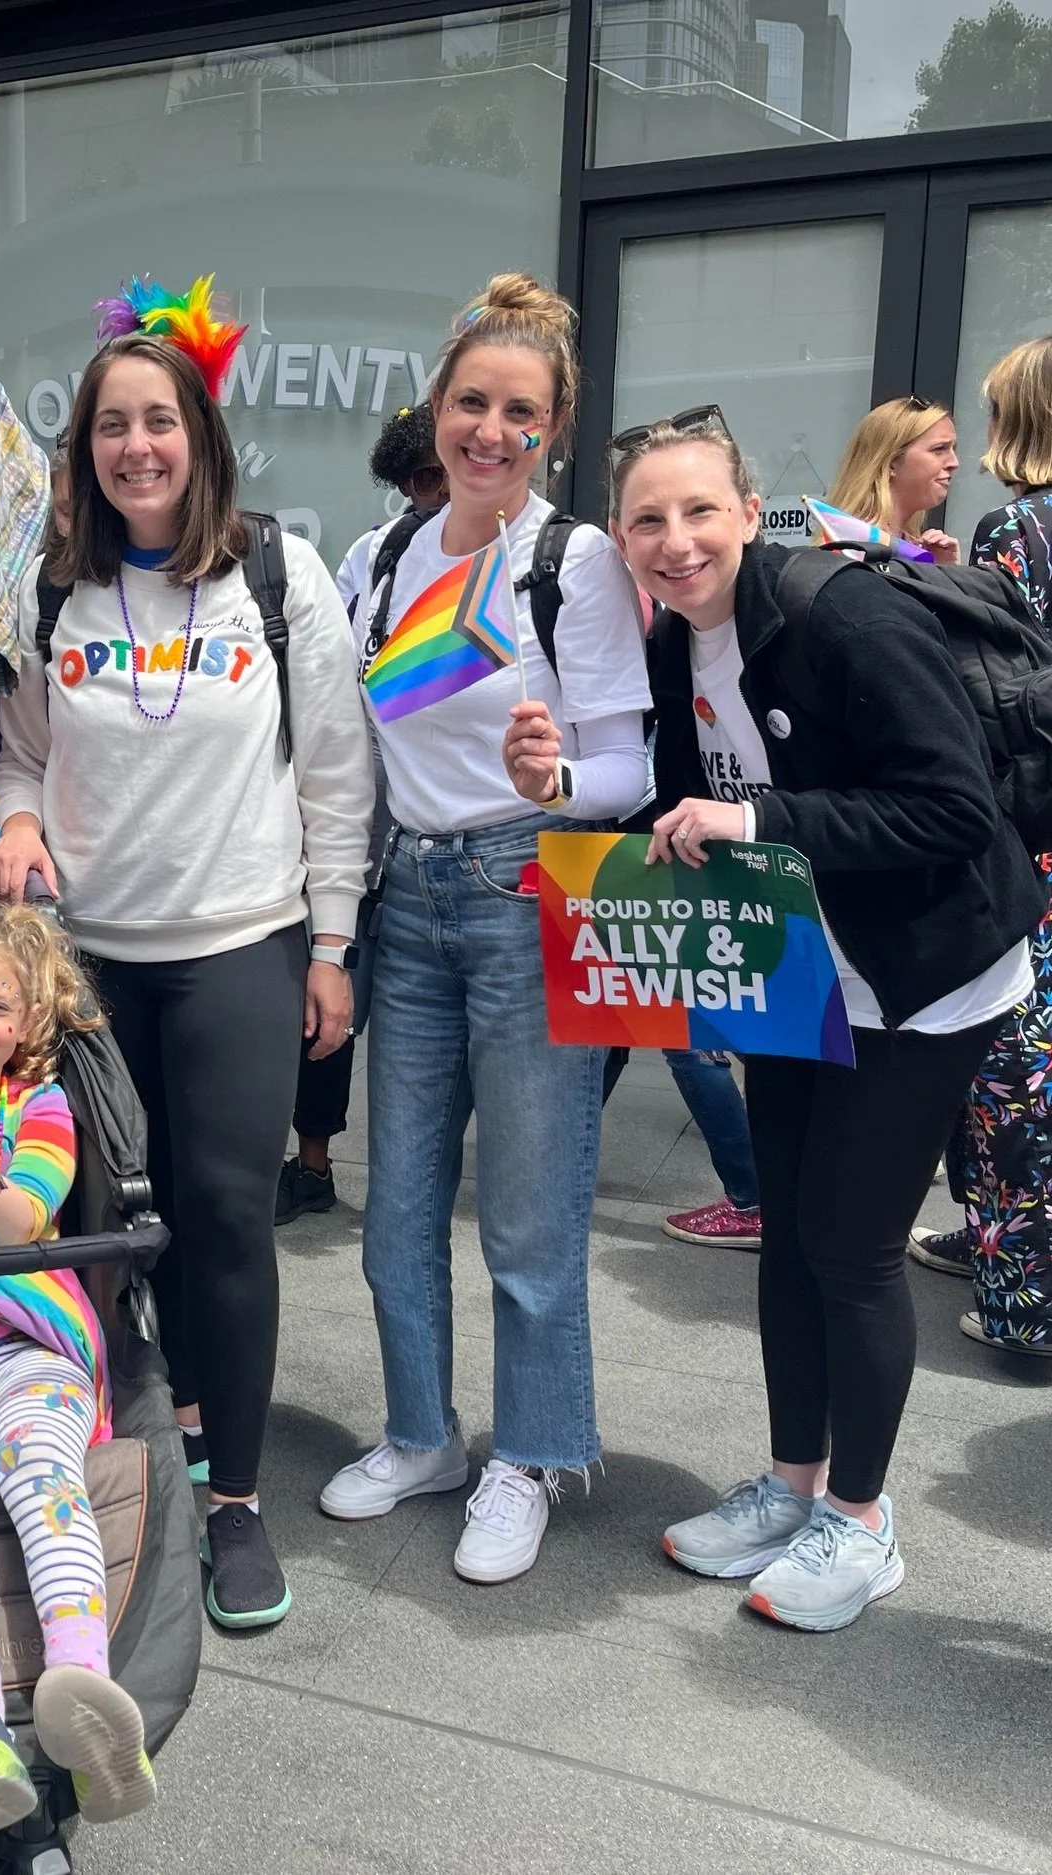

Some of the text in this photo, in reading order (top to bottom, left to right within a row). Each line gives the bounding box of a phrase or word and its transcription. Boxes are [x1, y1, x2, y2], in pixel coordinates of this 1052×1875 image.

[219, 343, 445, 413] WENTY
[759, 509, 805, 529] LOSED
[230, 615, 252, 634] the
[60, 637, 253, 689] OPTIMIST
[729, 752, 743, 780] &
[566, 897, 774, 925] PROUD TO BE AN
[571, 923, 746, 967] ALLY &
[573, 966, 767, 1013] JEWISH
